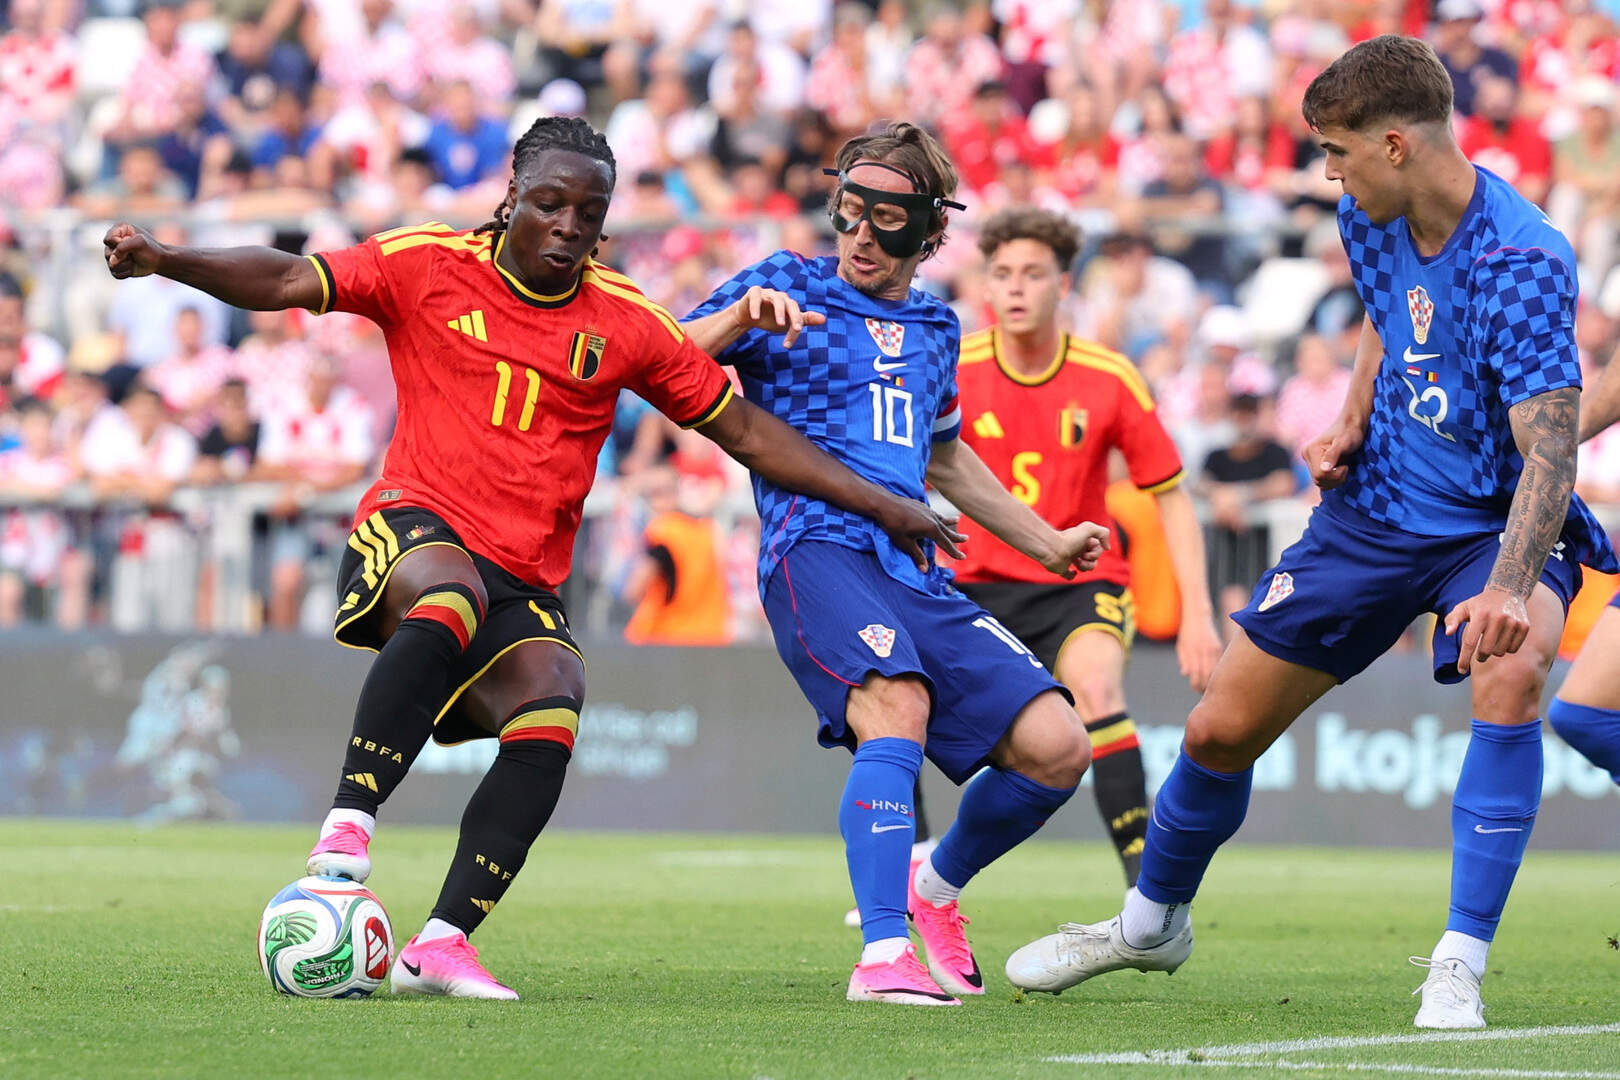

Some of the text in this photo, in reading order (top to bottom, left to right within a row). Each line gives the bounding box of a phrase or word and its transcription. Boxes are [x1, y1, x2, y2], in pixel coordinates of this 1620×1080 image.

[491, 361, 541, 432] 11
[869, 382, 914, 448] 10
[1011, 451, 1043, 507] 5
[352, 736, 403, 764] RBFA
[871, 799, 908, 815] HNS
[475, 854, 513, 881] RBF
